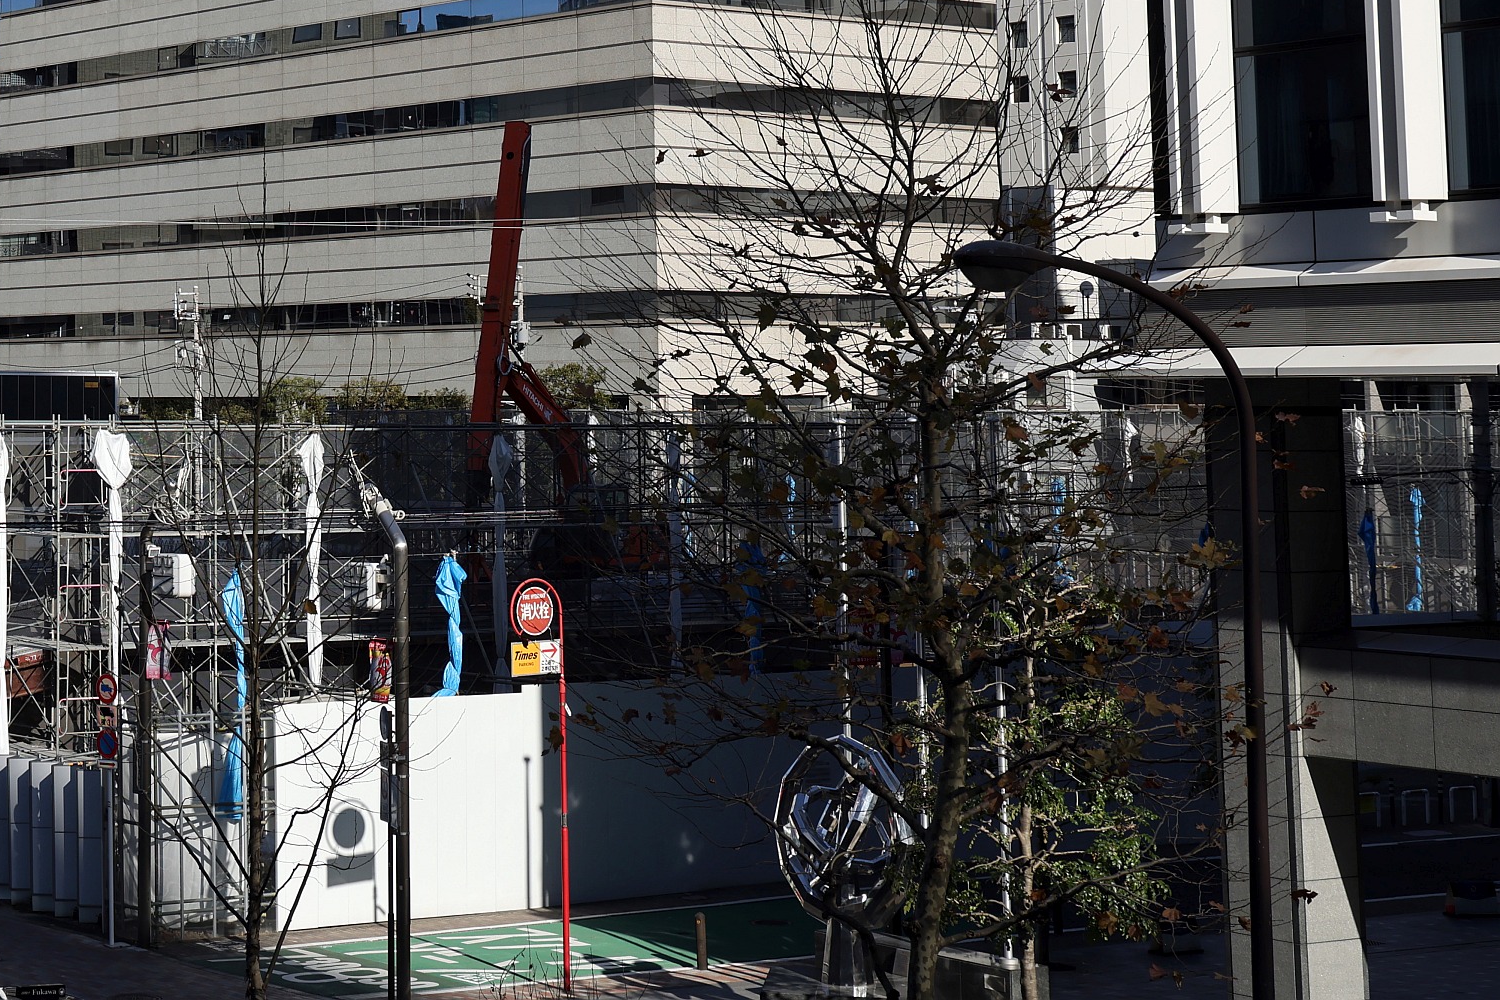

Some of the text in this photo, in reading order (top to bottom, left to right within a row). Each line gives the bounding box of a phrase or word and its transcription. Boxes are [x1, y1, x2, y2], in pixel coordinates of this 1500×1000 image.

[522, 384, 544, 412] HITACHI
[520, 601, 550, 621] 消火栓
[514, 651, 539, 661] Times
